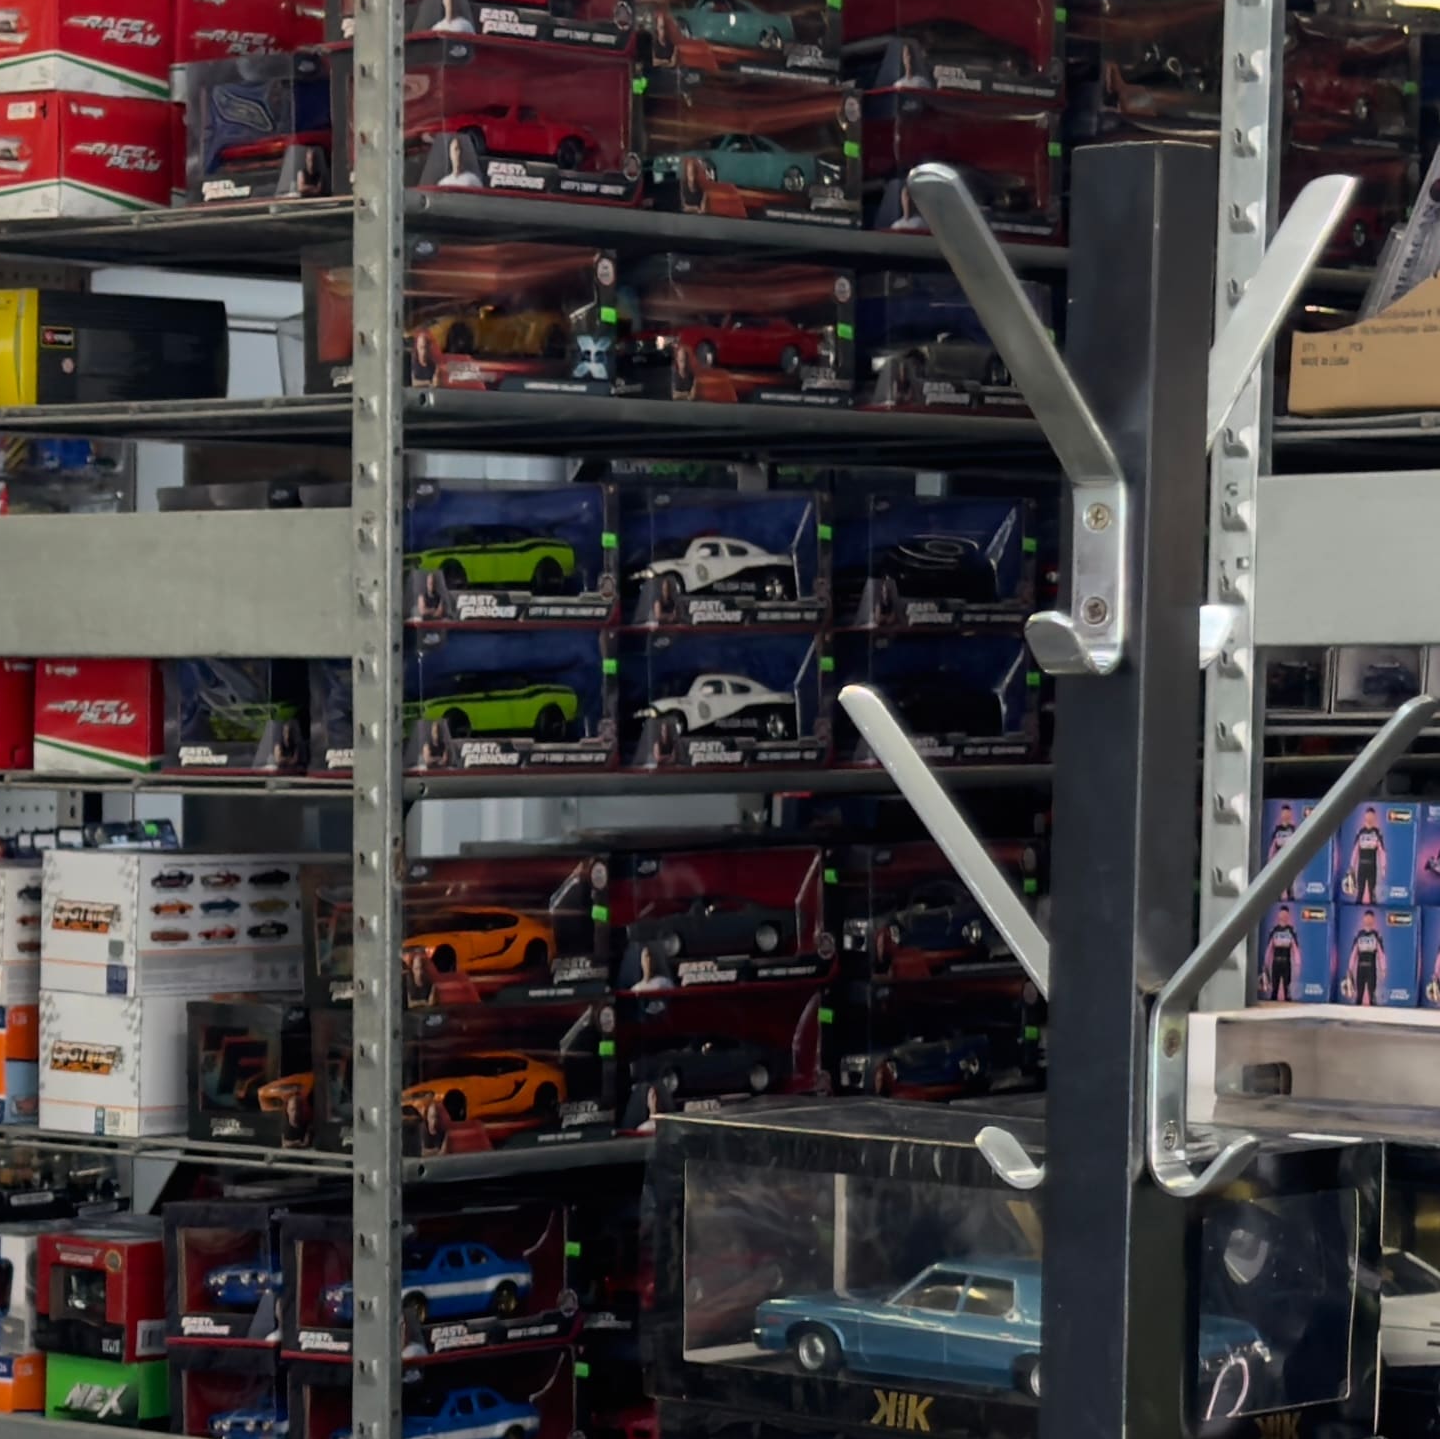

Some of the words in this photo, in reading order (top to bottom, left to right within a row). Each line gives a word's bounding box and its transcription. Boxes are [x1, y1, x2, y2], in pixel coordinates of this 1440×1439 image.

[102, 27, 162, 48] PLAY
[76, 709, 135, 727] PLAY
[65, 1384, 128, 1418] NEX
